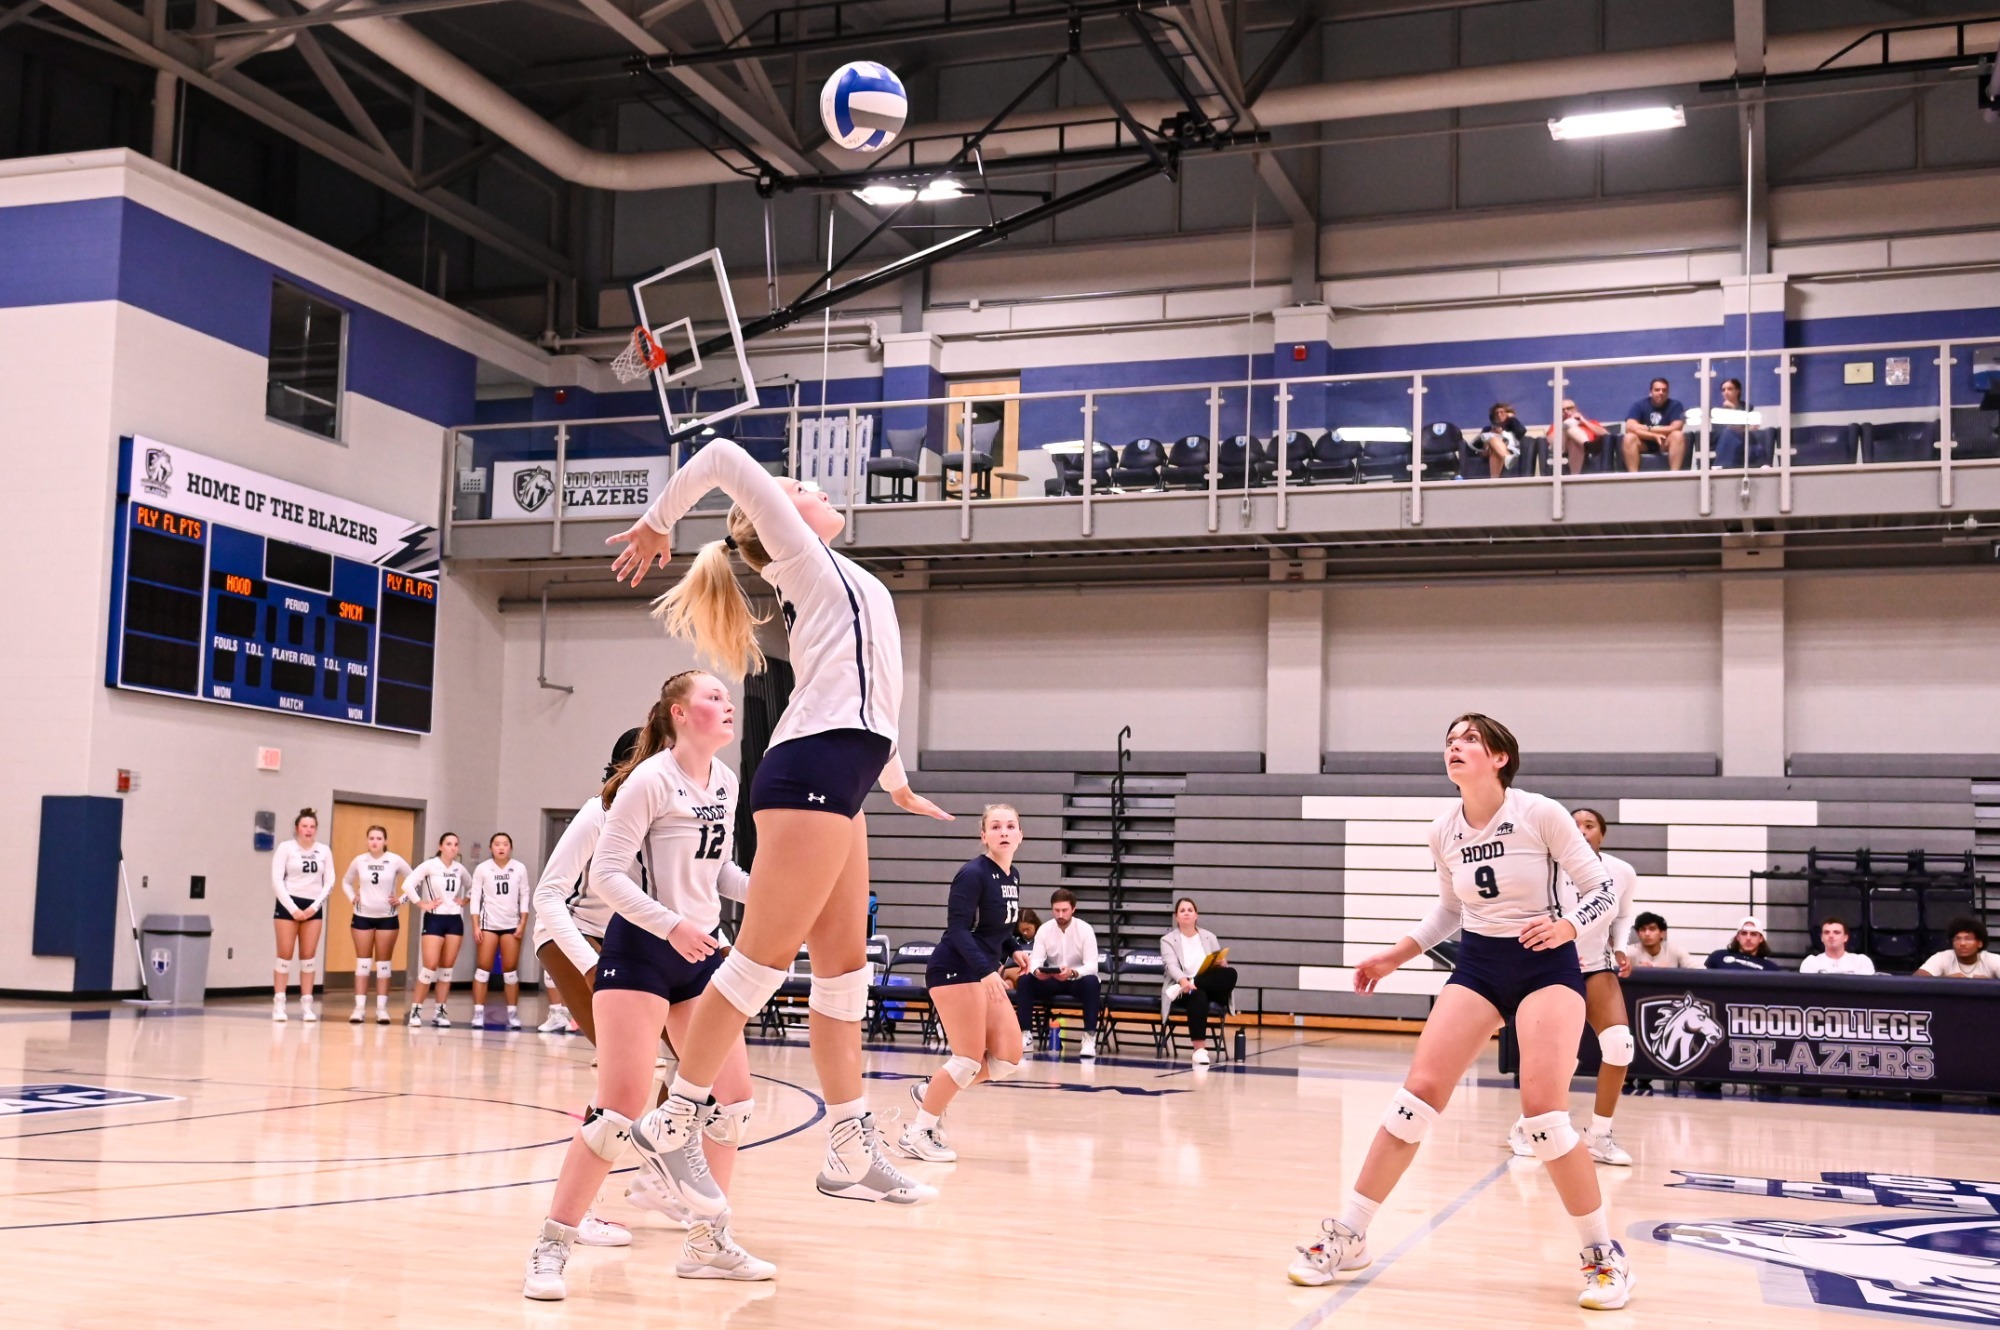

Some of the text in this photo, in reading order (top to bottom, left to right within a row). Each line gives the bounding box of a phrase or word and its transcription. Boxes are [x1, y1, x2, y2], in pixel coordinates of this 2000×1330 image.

[564, 470, 649, 489] OOD COLLEGE
[186, 472, 240, 506] HOME
[245, 490, 266, 513] OF
[270, 498, 304, 524] THE
[308, 507, 379, 546] BLAZERS
[137, 506, 201, 540] PLY FL PTS
[226, 575, 252, 596] HOOD
[386, 573, 434, 599] PLY FL PTS
[285, 598, 310, 614] PERIOD
[339, 602, 363, 621] SMCM
[214, 636, 238, 652] FOULS
[271, 647, 316, 667] PLAYER FOUL
[347, 662, 368, 677] FOULS
[213, 685, 231, 700] WON
[279, 696, 303, 711] MATCH
[348, 707, 363, 720] WON
[691, 804, 727, 821] HOOD
[694, 824, 726, 859] 12
[1460, 840, 1505, 864] HOOD
[302, 860, 318, 873] 20
[371, 872, 379, 885] 3
[445, 879, 456, 892] 11
[496, 881, 509, 895] 10
[1474, 865, 1501, 899] 9
[1727, 1004, 1932, 1044] HOOD COLLEGE
[1729, 1039, 1935, 1080] BLAZERS
